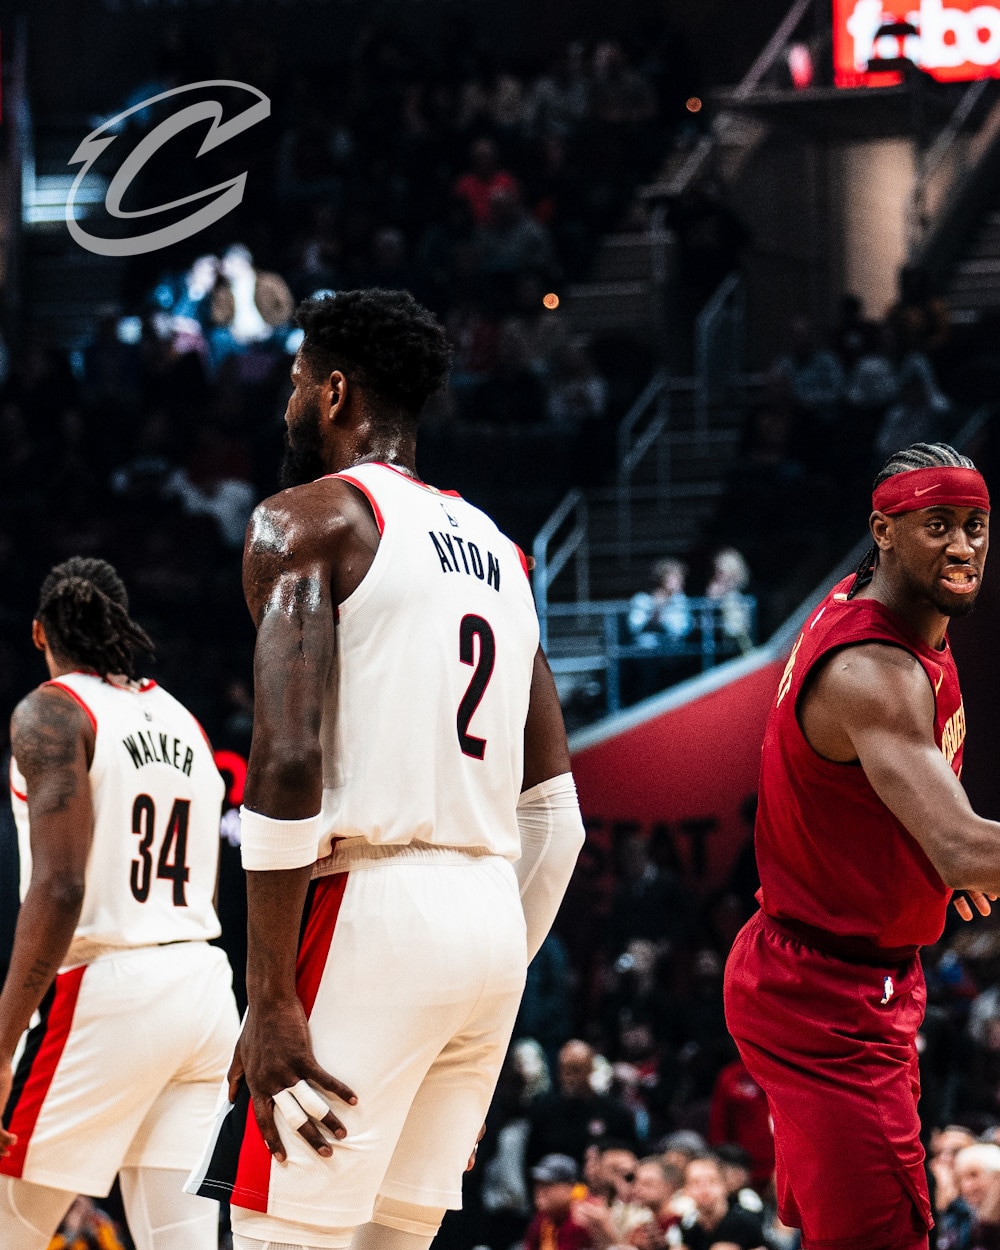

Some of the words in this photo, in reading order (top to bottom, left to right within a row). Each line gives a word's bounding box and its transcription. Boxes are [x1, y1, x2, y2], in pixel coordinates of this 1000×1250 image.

[428, 531, 501, 592] AYTON
[456, 613, 496, 761] 2
[123, 730, 194, 777] WALKER
[130, 793, 192, 908] 34
